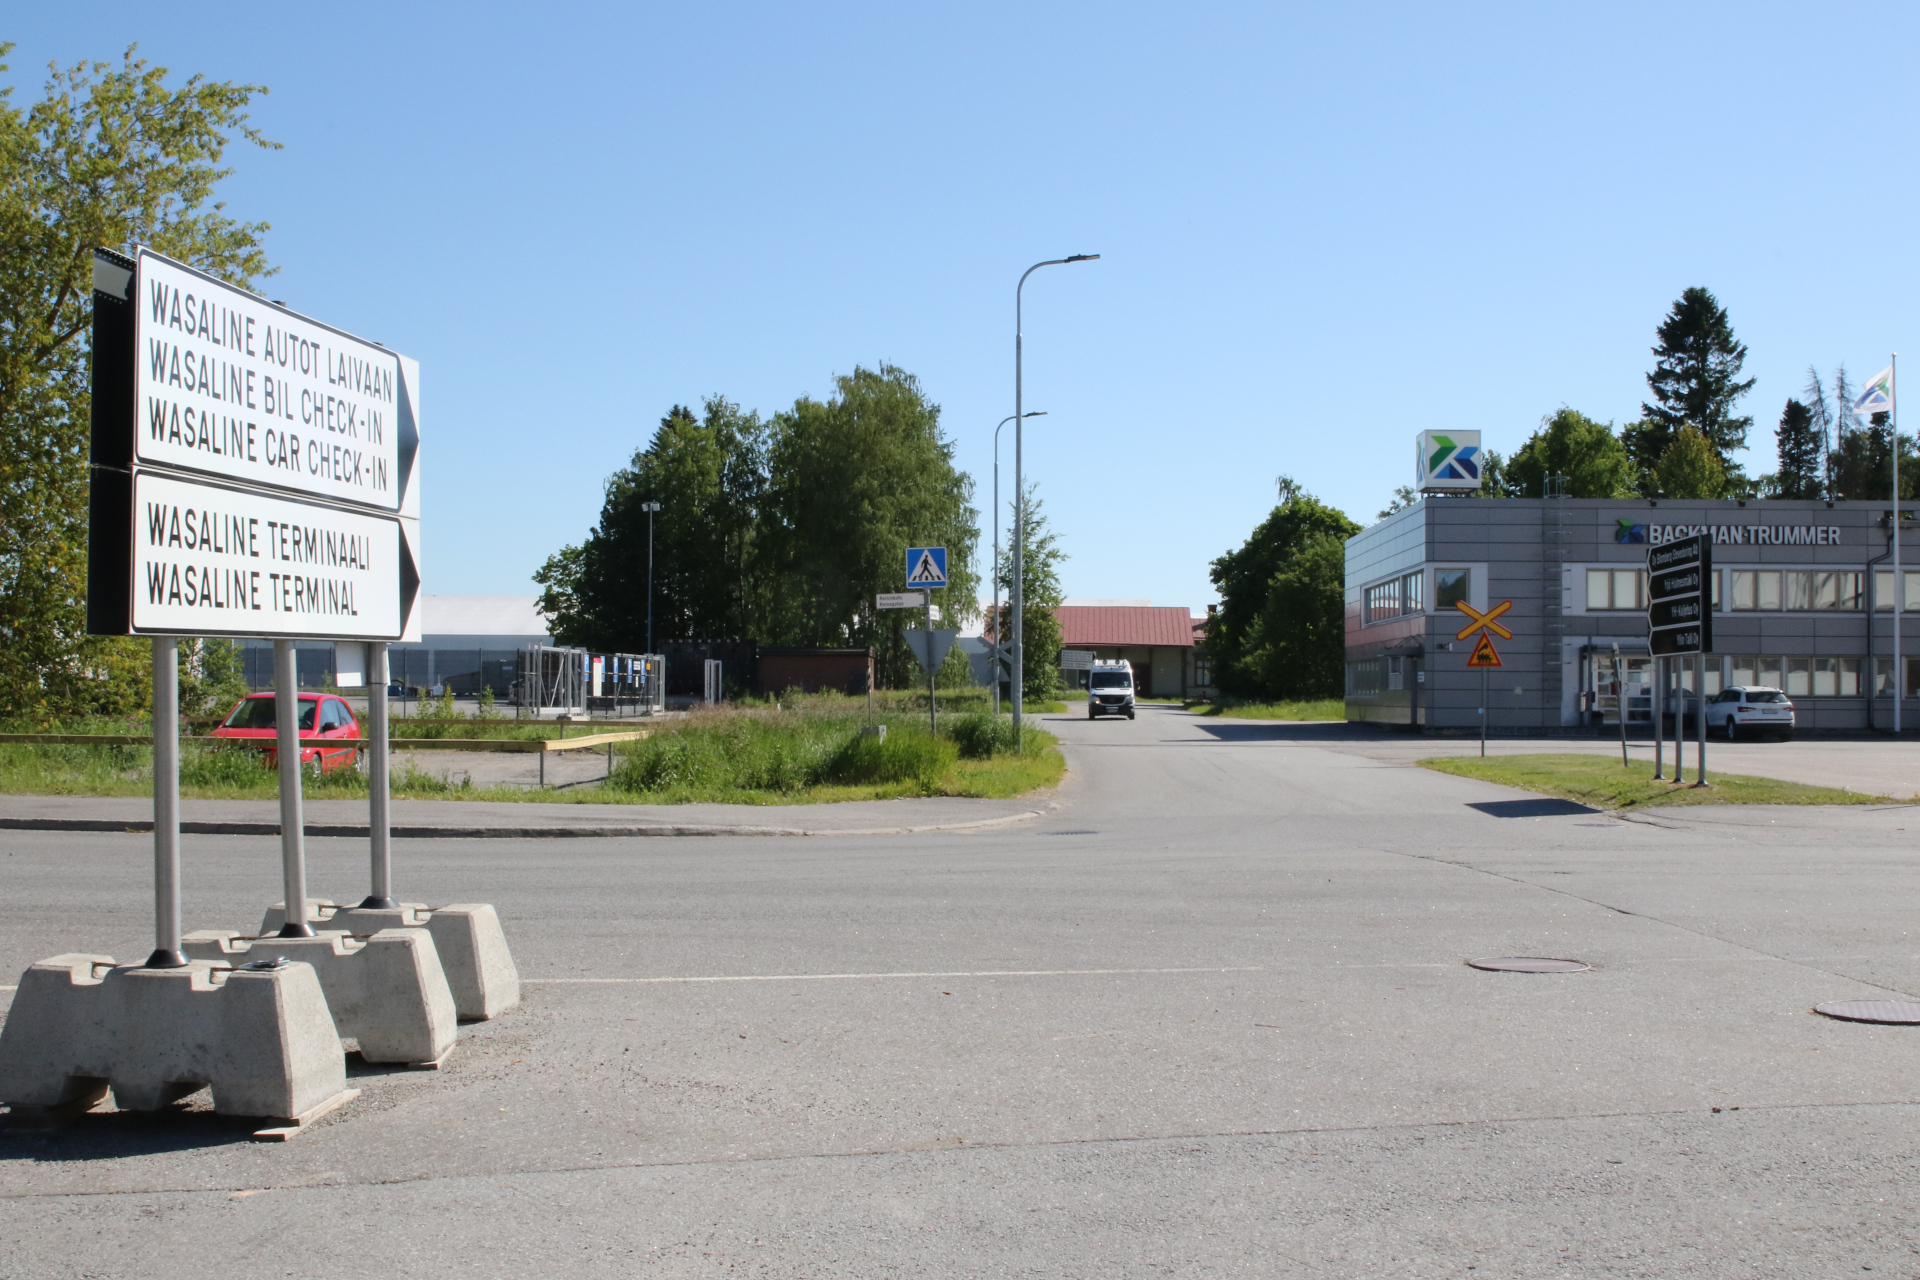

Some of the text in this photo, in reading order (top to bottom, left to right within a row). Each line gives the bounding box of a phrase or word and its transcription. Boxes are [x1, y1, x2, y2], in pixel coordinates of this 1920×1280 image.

[149, 337, 256, 410] WASALINE
[264, 375, 294, 421] BIL
[150, 278, 392, 405] WASALINE AUTOT LAIVAAN
[148, 396, 257, 463] WASALINE
[265, 428, 300, 472] CAR
[147, 502, 370, 571] WASALINE TERMINAALI
[147, 561, 358, 617] WASALINE TERMINAL
